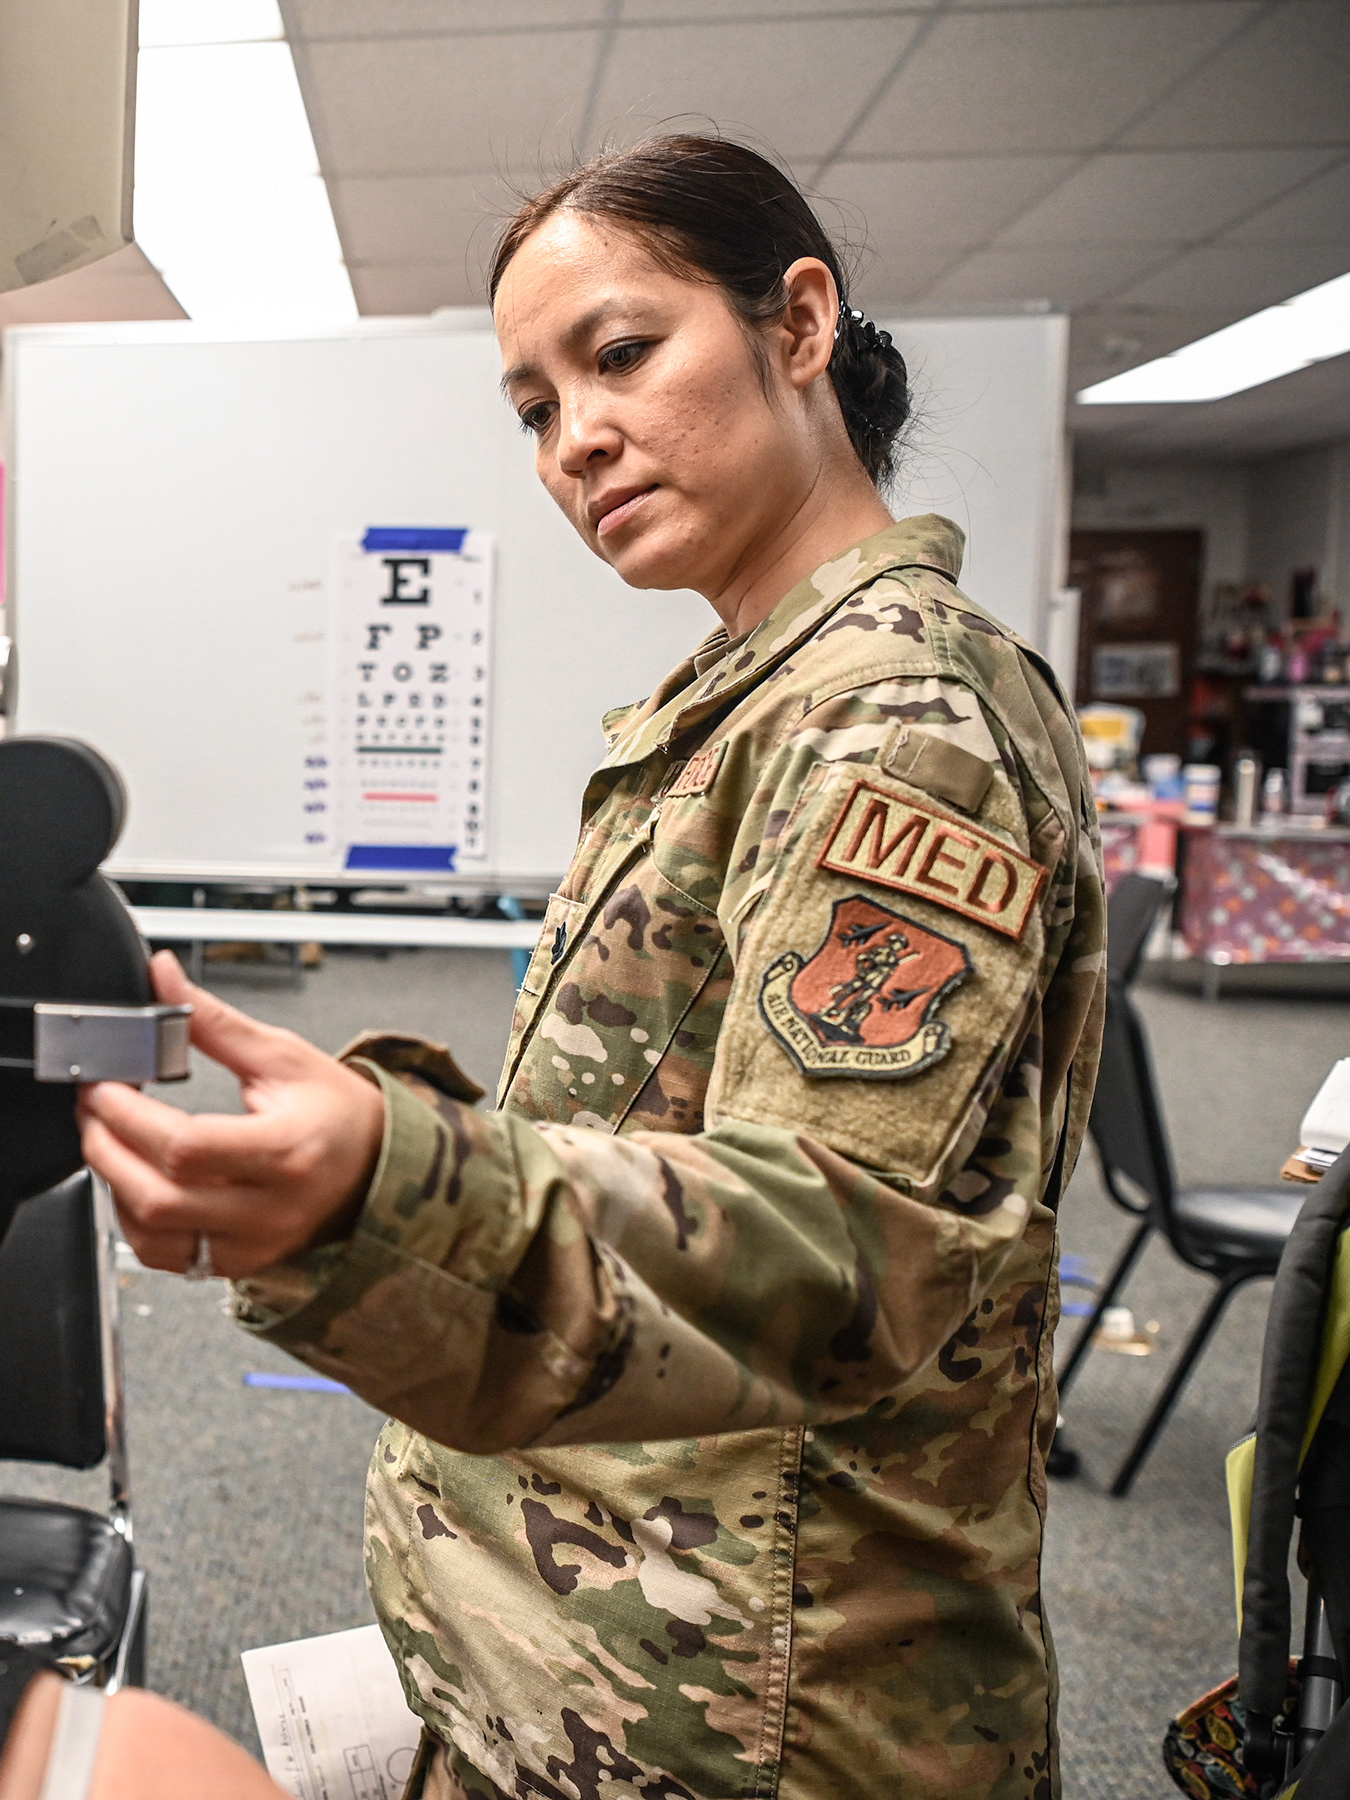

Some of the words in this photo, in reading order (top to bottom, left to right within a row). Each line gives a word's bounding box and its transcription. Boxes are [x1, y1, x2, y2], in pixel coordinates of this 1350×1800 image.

[380, 558, 430, 605] E
[417, 624, 442, 650] P
[843, 799, 1019, 914] MED
[768, 993, 788, 1020] AIR
[855, 1050, 912, 1065] GUARD
